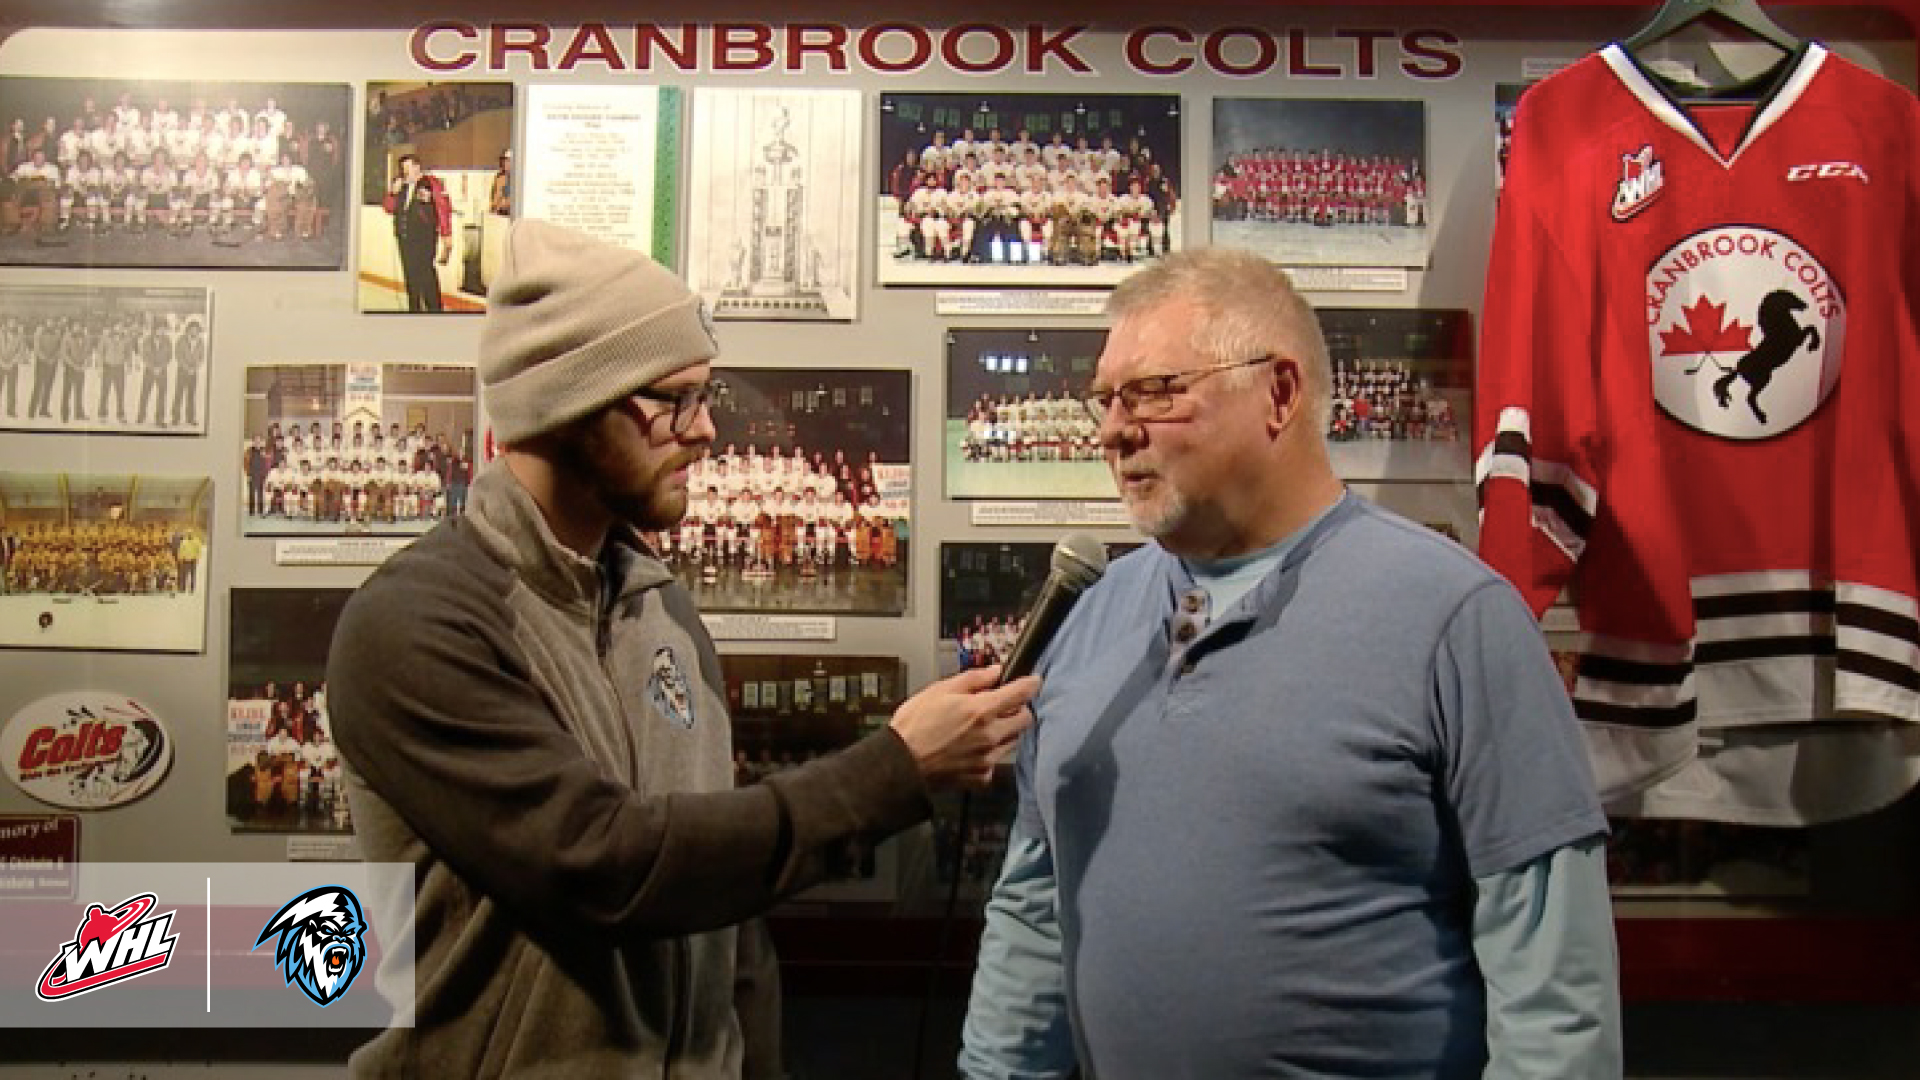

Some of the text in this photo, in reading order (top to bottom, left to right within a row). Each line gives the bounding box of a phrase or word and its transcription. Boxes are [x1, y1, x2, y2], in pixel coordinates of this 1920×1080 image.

[409, 22, 1463, 79] CRANBROOK COLTS
[1646, 233, 1841, 326] CRANBROOK COLTS
[18, 720, 128, 771] Colts
